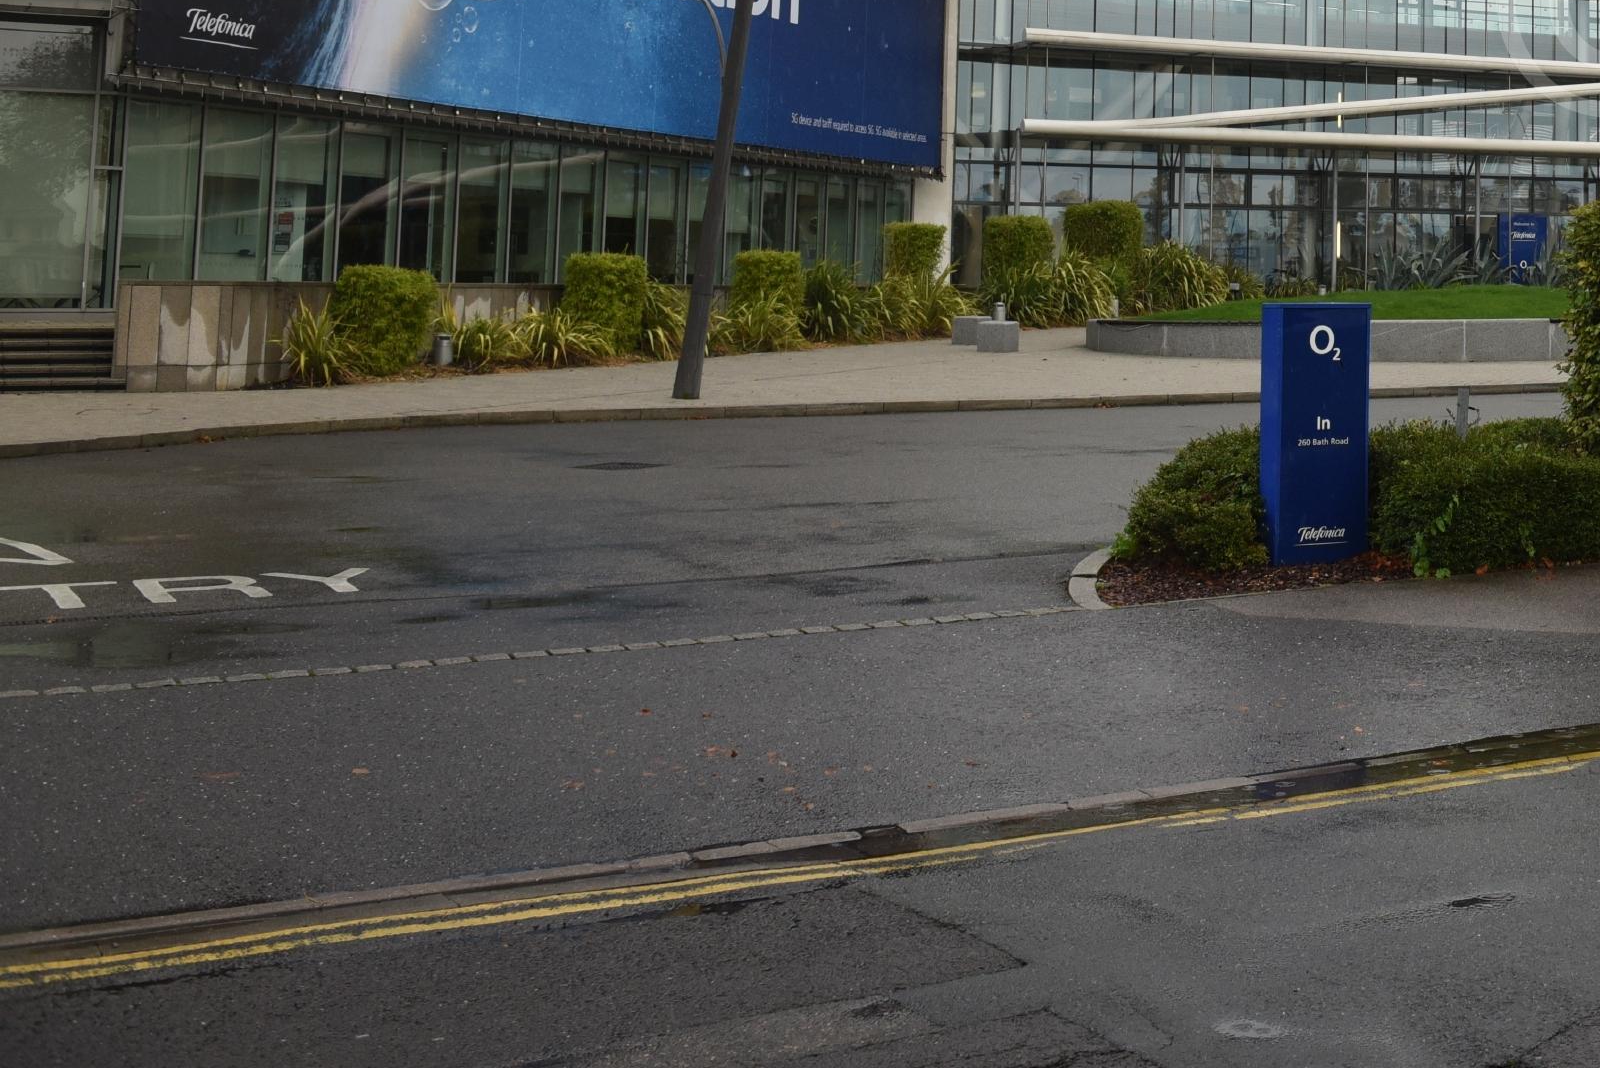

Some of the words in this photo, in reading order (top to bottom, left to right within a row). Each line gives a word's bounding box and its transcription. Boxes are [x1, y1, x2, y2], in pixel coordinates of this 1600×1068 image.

[1316, 416, 1331, 431] In
[1312, 437, 1329, 446] Bath
[1330, 436, 1349, 445] Road
